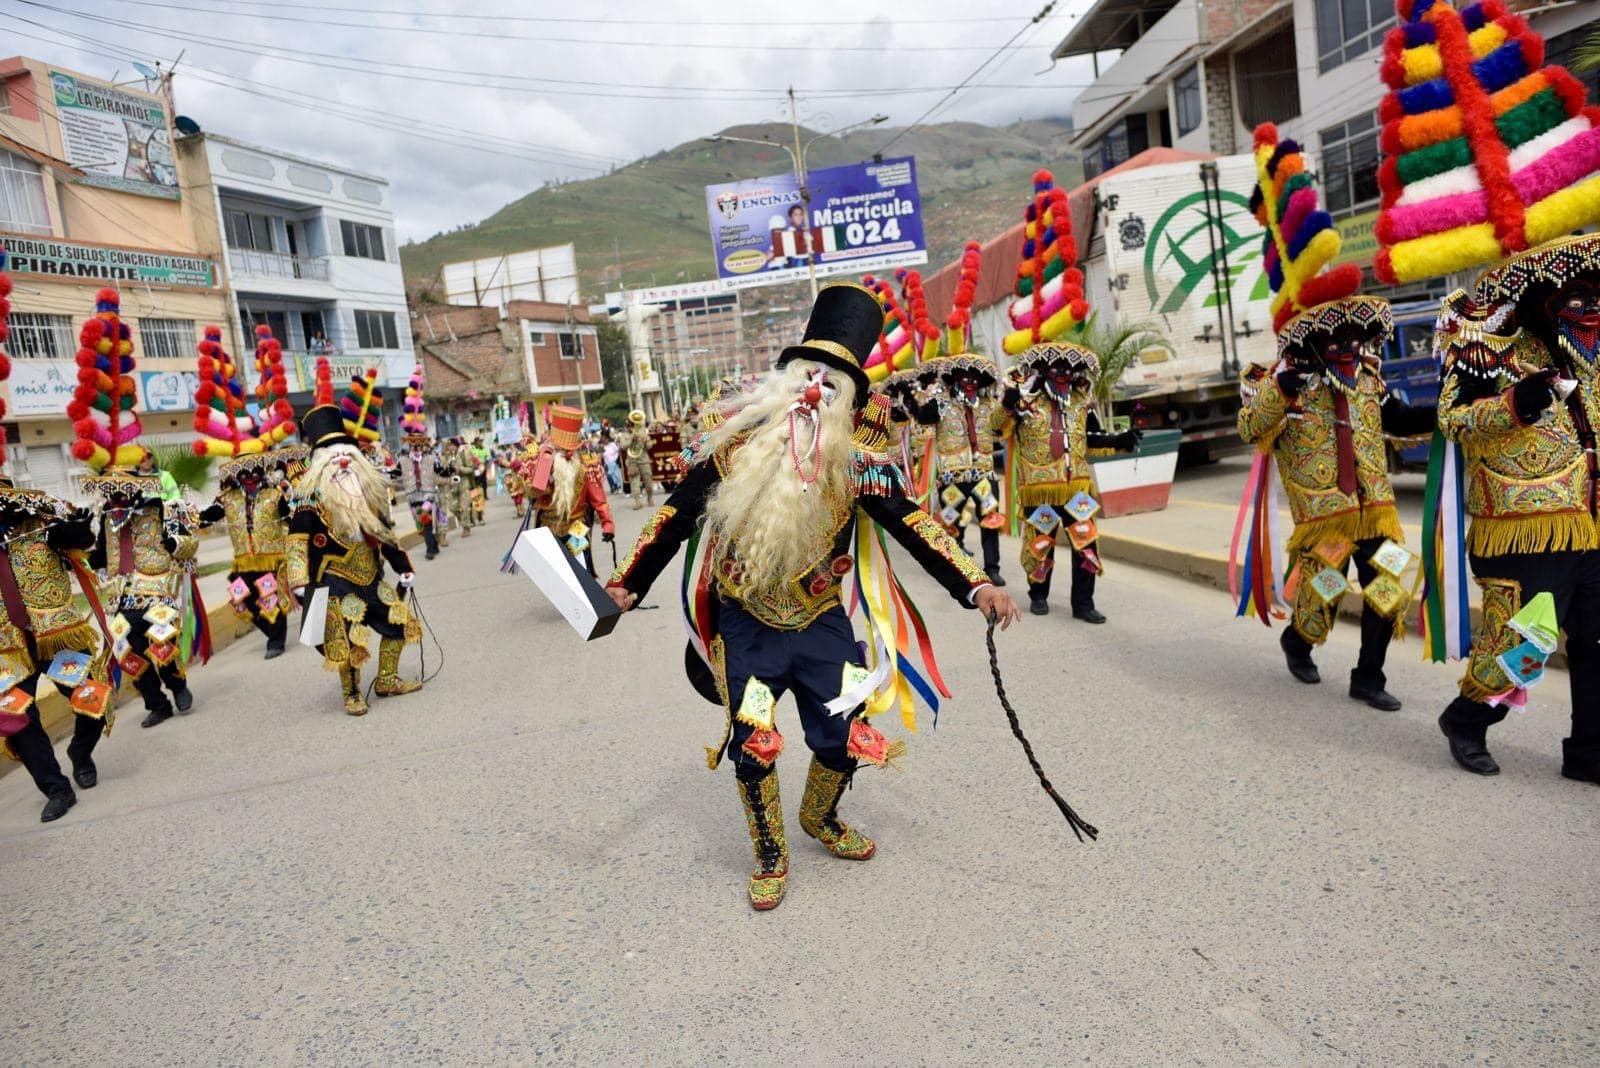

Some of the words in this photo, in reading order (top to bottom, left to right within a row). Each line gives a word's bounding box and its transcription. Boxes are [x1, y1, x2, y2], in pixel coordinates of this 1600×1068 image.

[76, 90, 93, 107] LA
[95, 96, 150, 121] PIRAMIDE
[741, 192, 801, 209] ENCINAS
[813, 197, 914, 227] Matrícula
[845, 218, 902, 246] 024
[0, 238, 46, 256] ATORIO
[49, 244, 63, 259] DE
[65, 246, 106, 263] SUELOS
[110, 250, 161, 268] CONCRETO
[162, 258, 169, 267] Y
[171, 258, 208, 272] ASFALTO
[11, 256, 138, 280] PIRAMIDE
